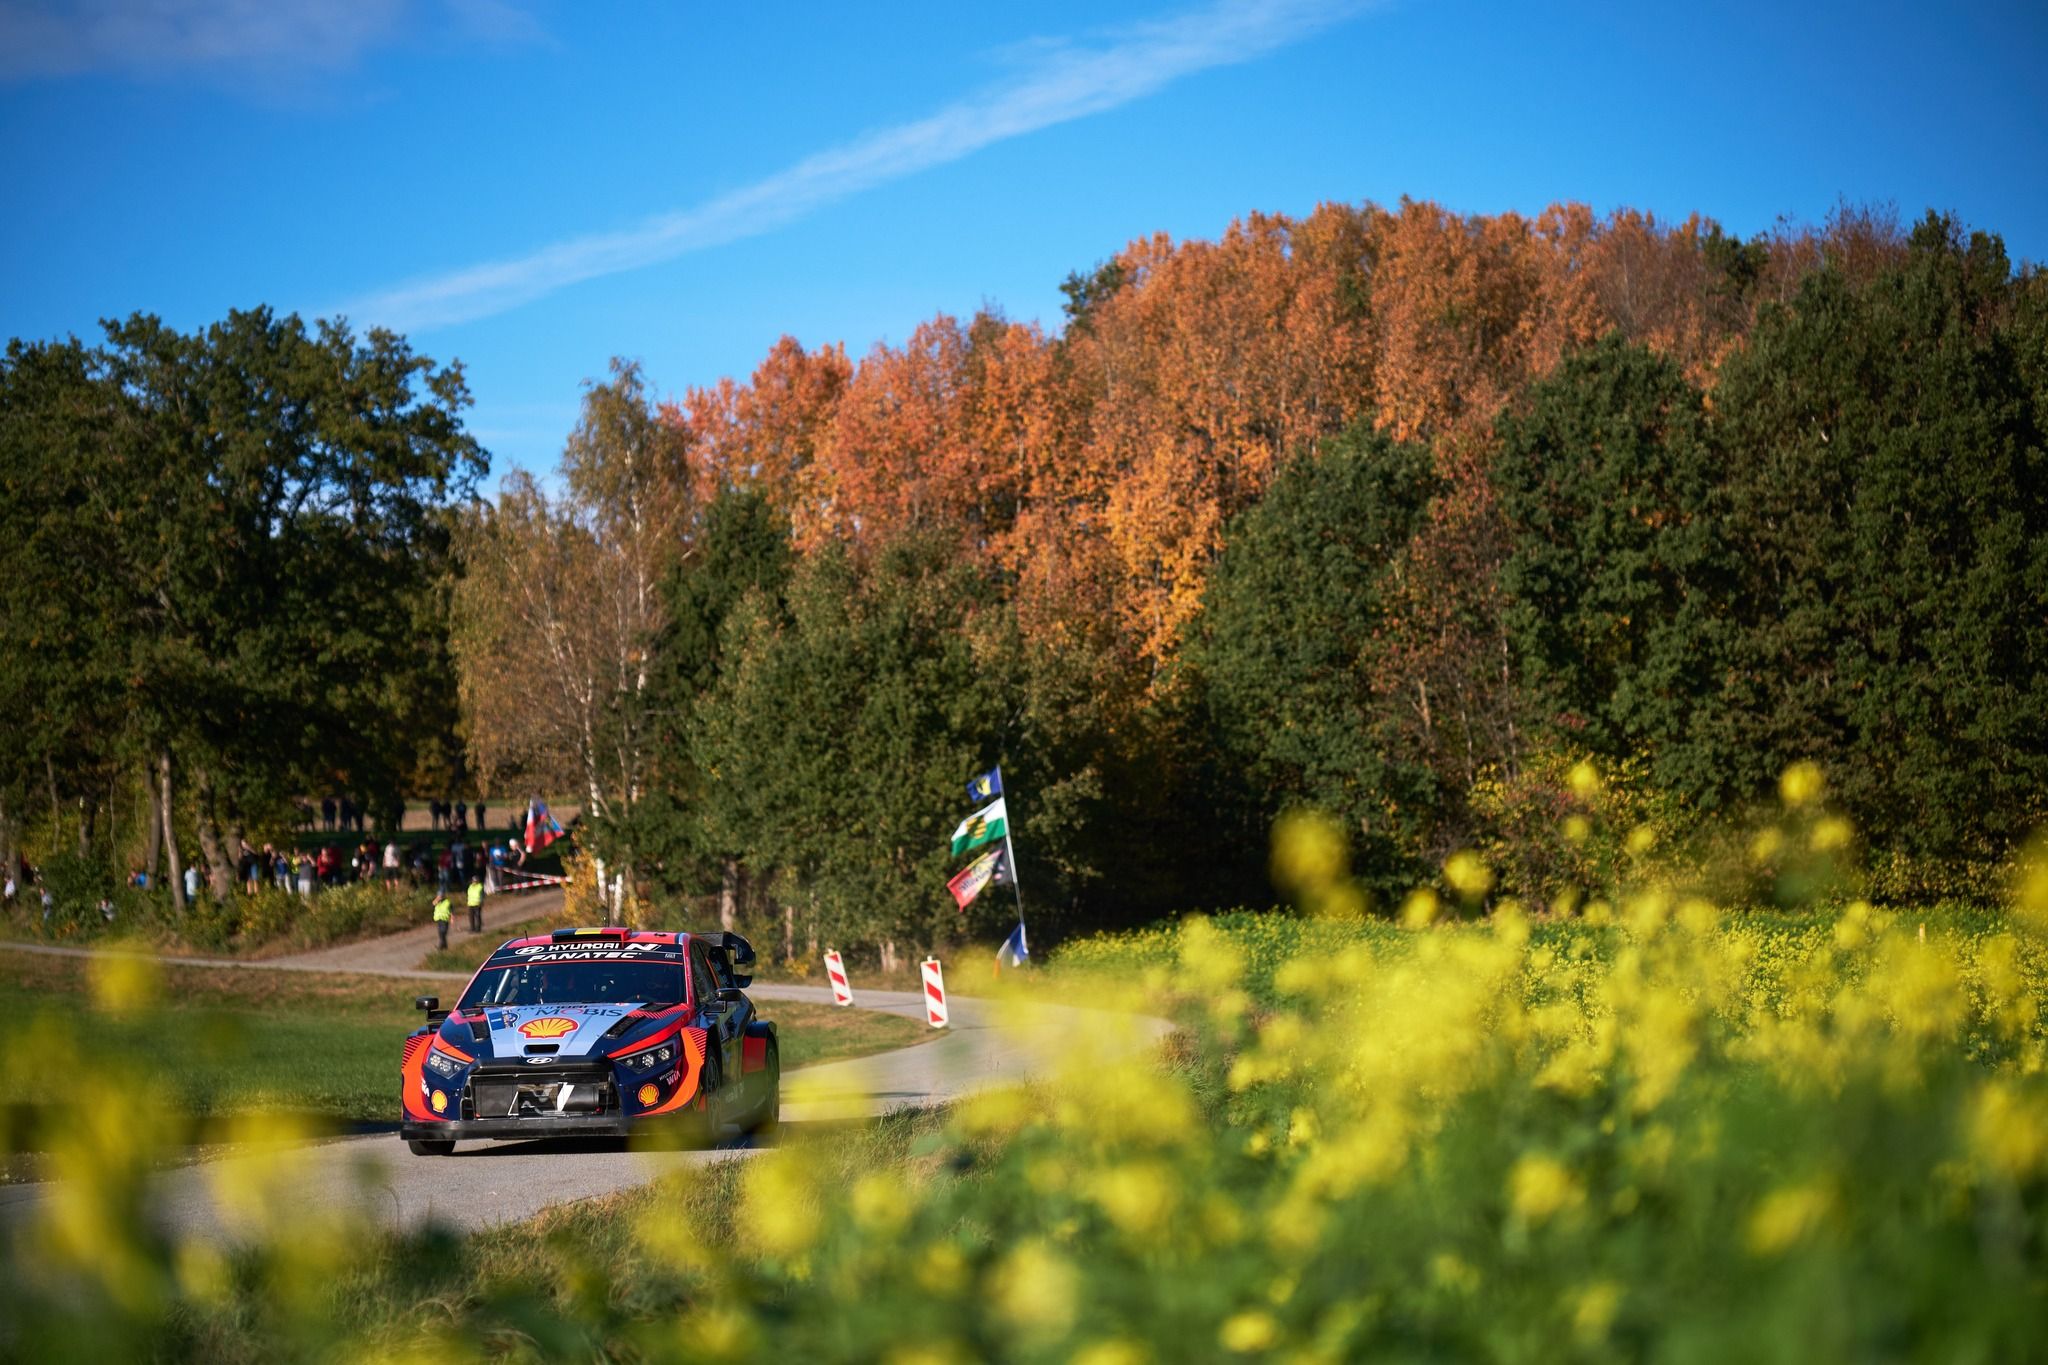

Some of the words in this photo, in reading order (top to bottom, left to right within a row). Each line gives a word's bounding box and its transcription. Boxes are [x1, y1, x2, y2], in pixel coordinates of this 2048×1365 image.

[548, 942, 620, 952] HYUNDAI
[527, 952, 639, 962] FANATEC
[535, 1007, 623, 1017] MOBIS
